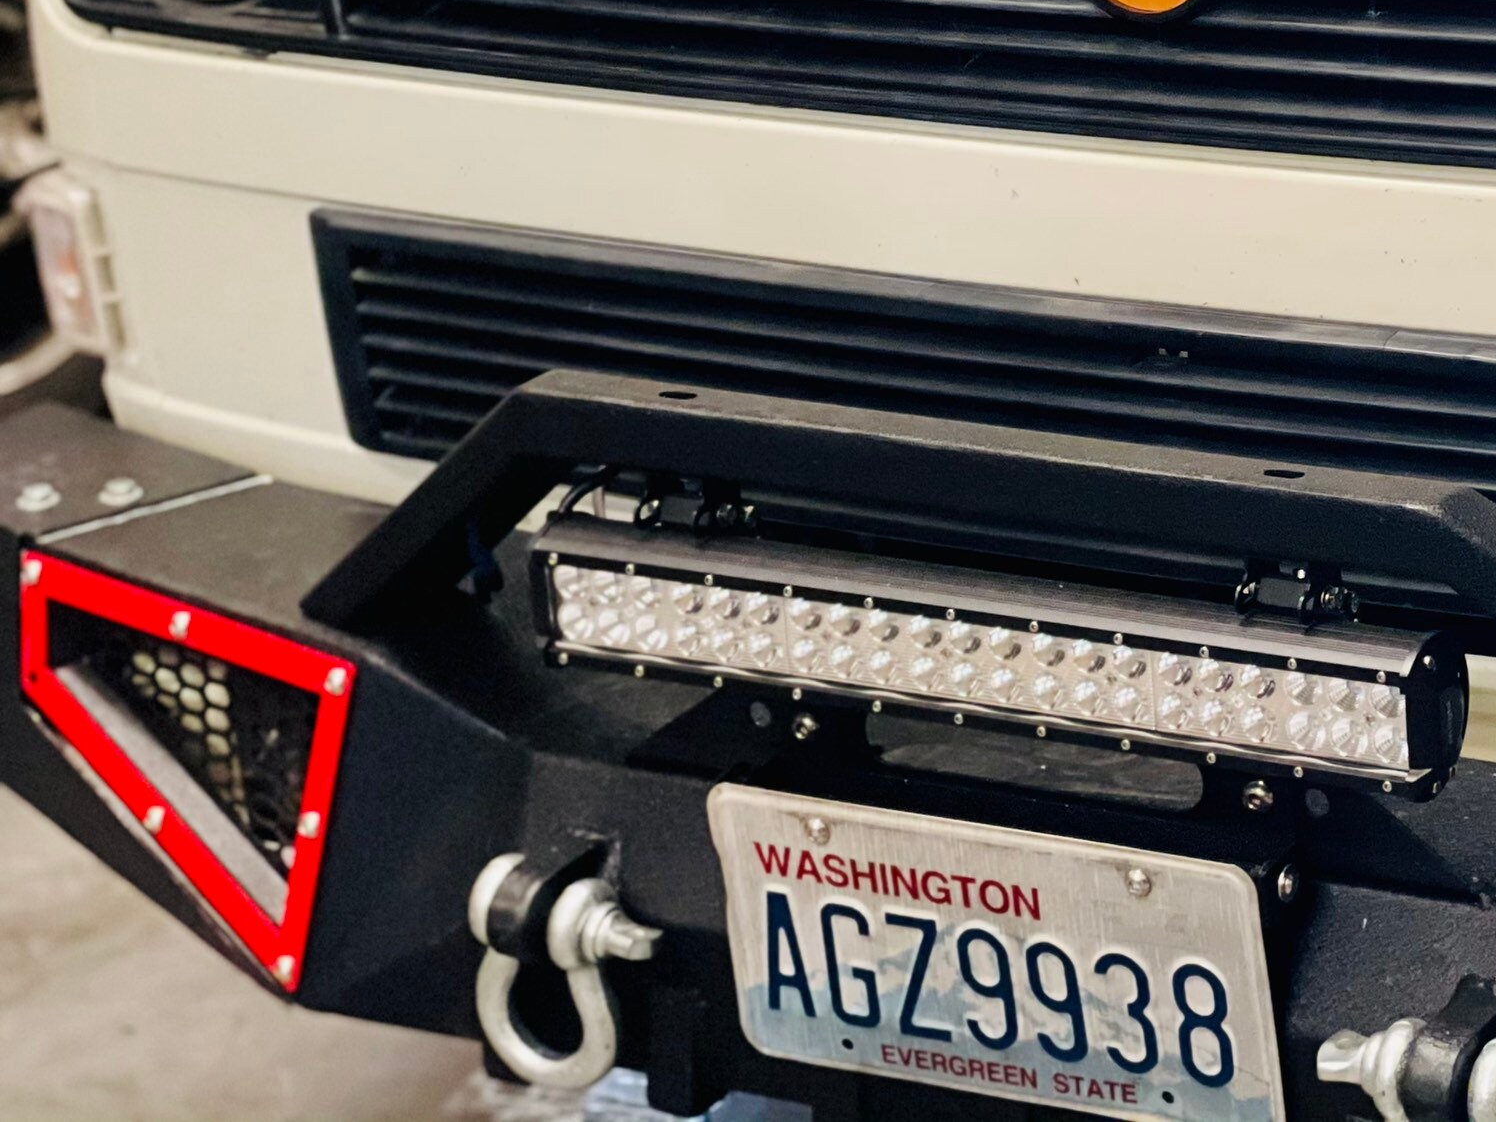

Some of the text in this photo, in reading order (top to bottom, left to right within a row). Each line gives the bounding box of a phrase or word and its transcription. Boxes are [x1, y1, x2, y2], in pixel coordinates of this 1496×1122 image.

[754, 842, 1041, 920] WASHINGTON
[767, 891, 1234, 1087] AGZ9938
[881, 1045, 1138, 1104] EVERGREEN STATE
